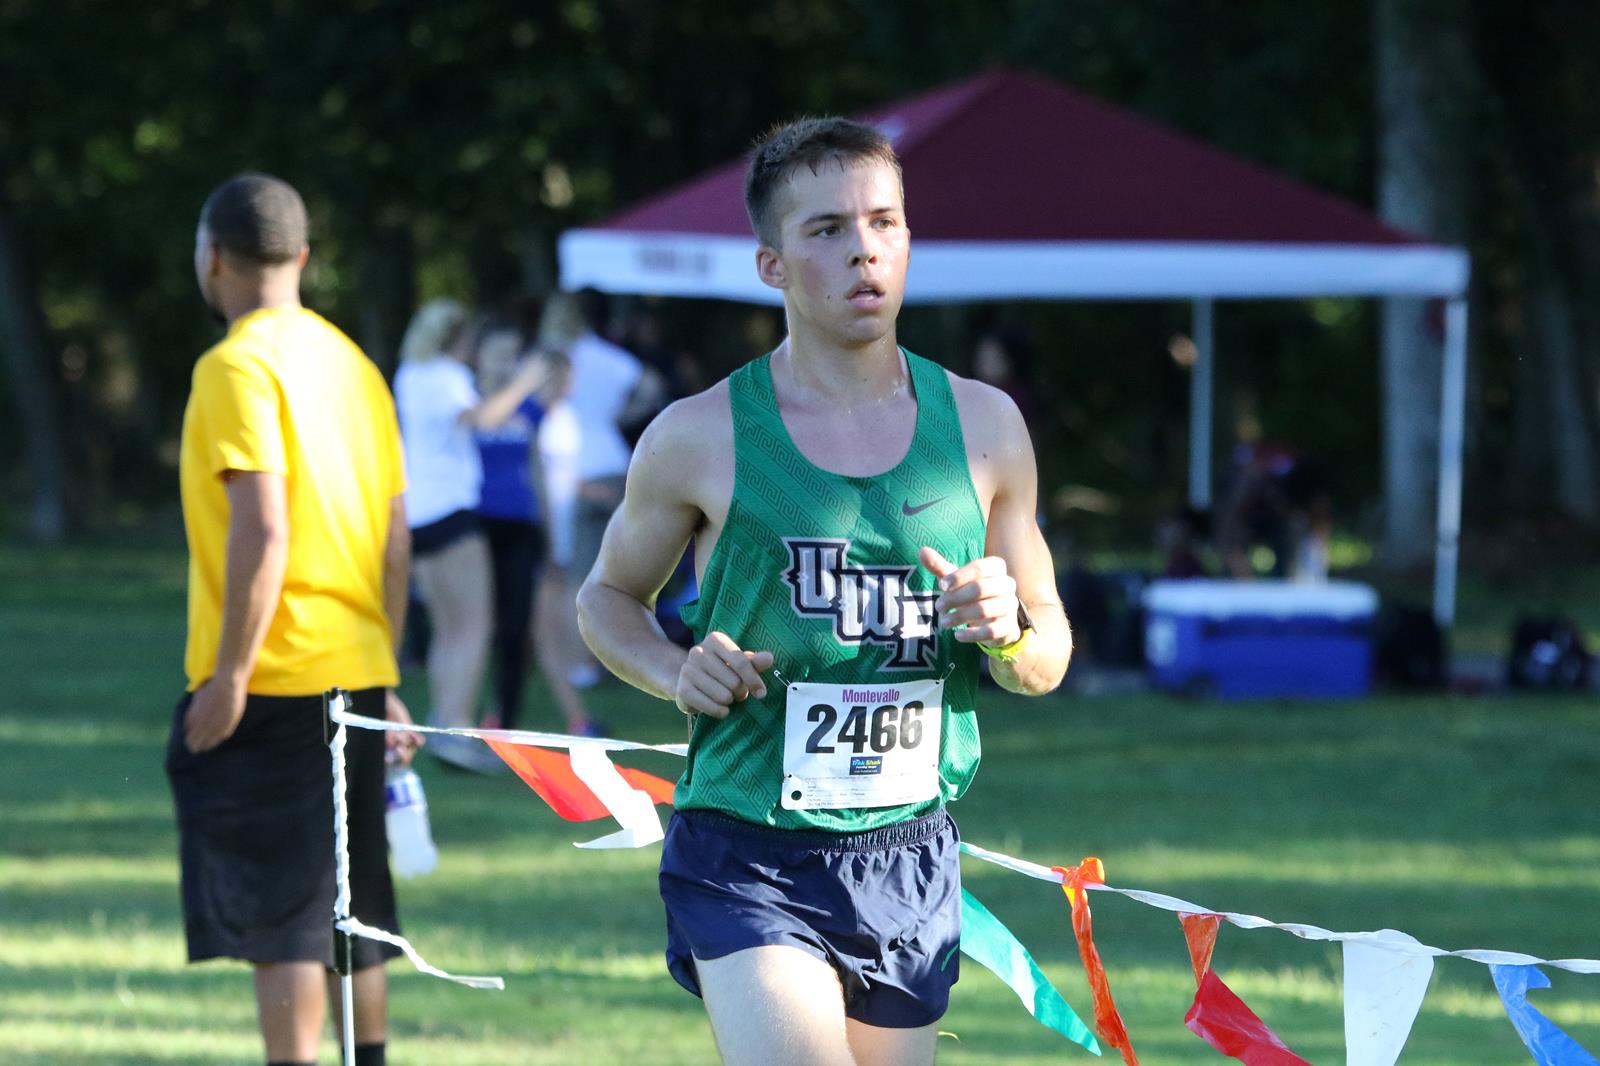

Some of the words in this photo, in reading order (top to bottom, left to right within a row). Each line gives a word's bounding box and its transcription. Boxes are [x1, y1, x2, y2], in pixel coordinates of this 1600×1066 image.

[780, 536, 940, 672] UWF
[842, 688, 900, 703] Montevallo
[805, 700, 924, 754] 2466
